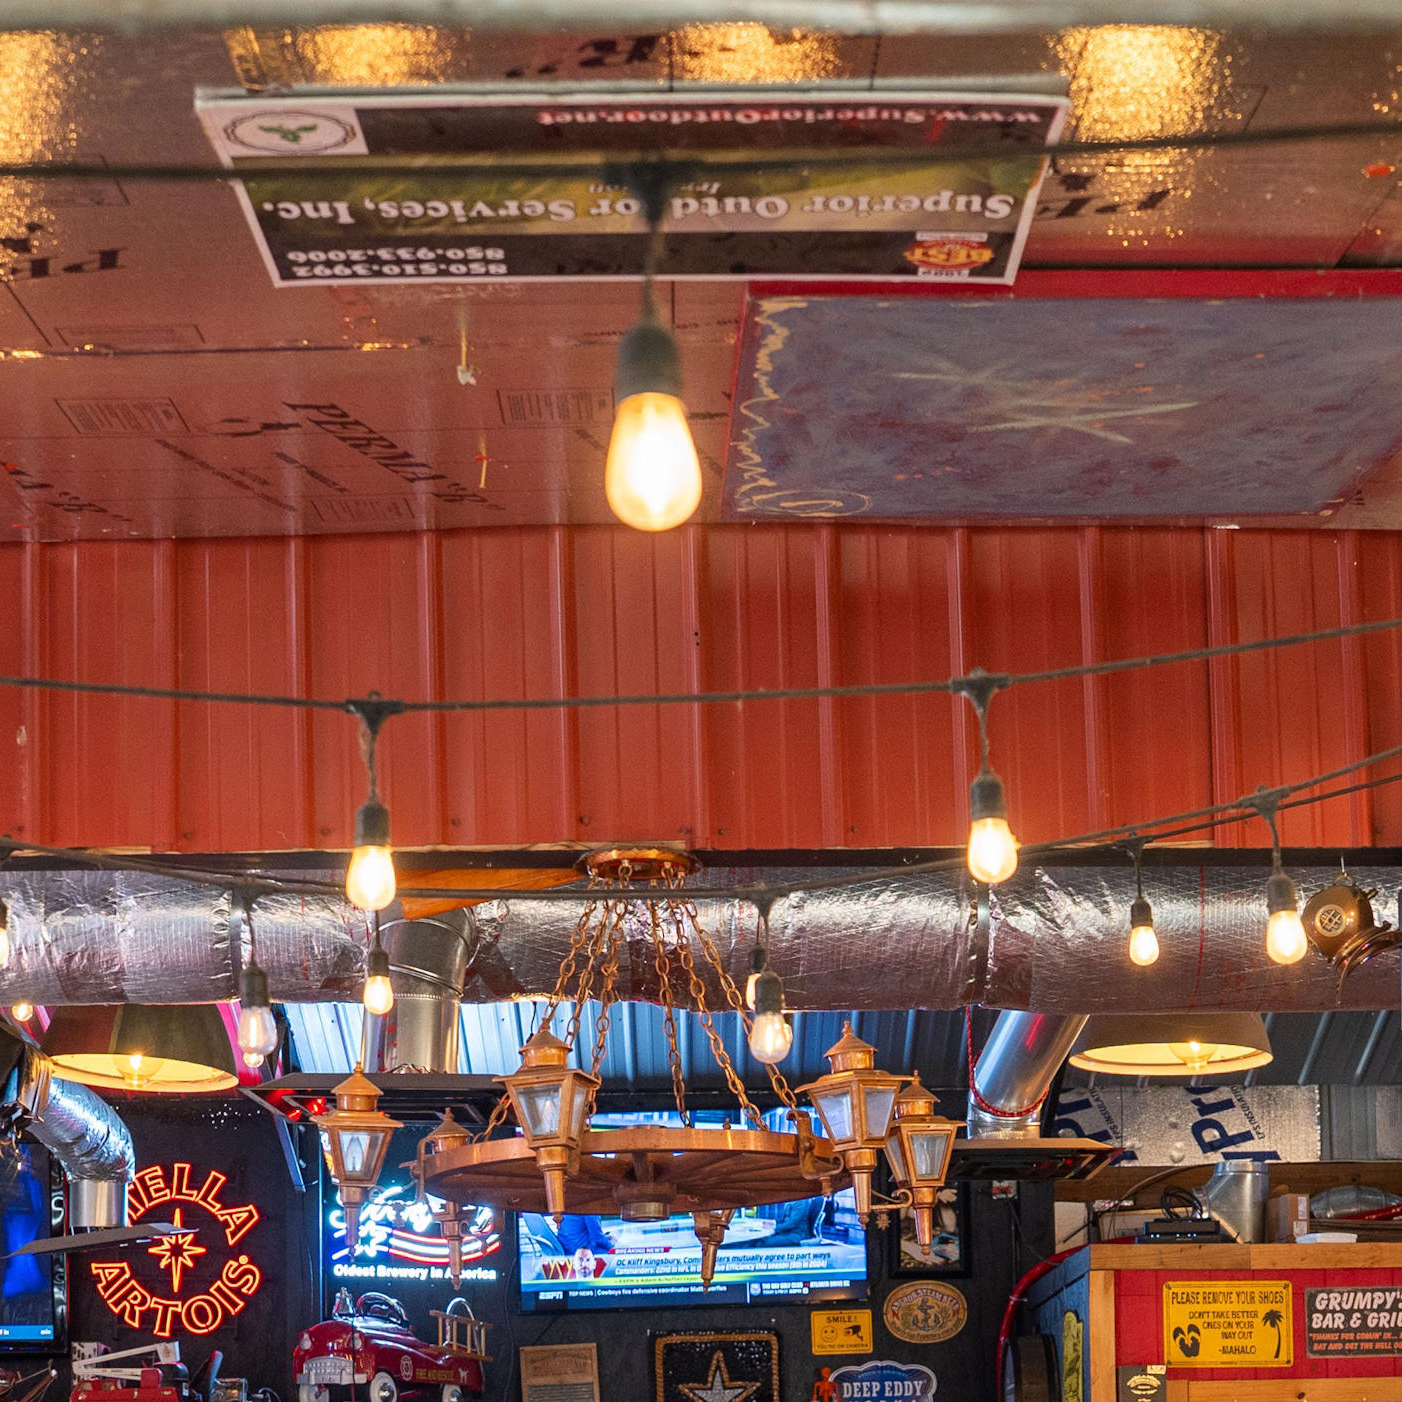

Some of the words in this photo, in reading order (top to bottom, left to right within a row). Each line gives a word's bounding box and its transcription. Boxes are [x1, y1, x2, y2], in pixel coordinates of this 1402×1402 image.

[262, 200, 355, 226] Inc.
[364, 196, 577, 223] Services,
[803, 191, 1015, 220] Superior
[334, 1265, 376, 1277] Oldest
[377, 1265, 428, 1280] Brewery
[90, 1261, 262, 1337] ARTOIS
[1171, 1291, 1200, 1306] PLEASE
[1202, 1290, 1233, 1305] REMOVE
[1235, 1290, 1256, 1305] YOUR
[1258, 1290, 1284, 1305] SHOES
[1188, 1311, 1210, 1320] DON'T
[1210, 1311, 1230, 1320] TAKE
[1231, 1310, 1259, 1320] BETTER
[1311, 1312, 1345, 1330] BAR
[1350, 1312, 1361, 1328] &
[1235, 1321, 1254, 1330] YOUR
[1237, 1331, 1254, 1340] OUT
[842, 1381, 881, 1398] DEEP
[884, 1380, 924, 1397] EDDY
